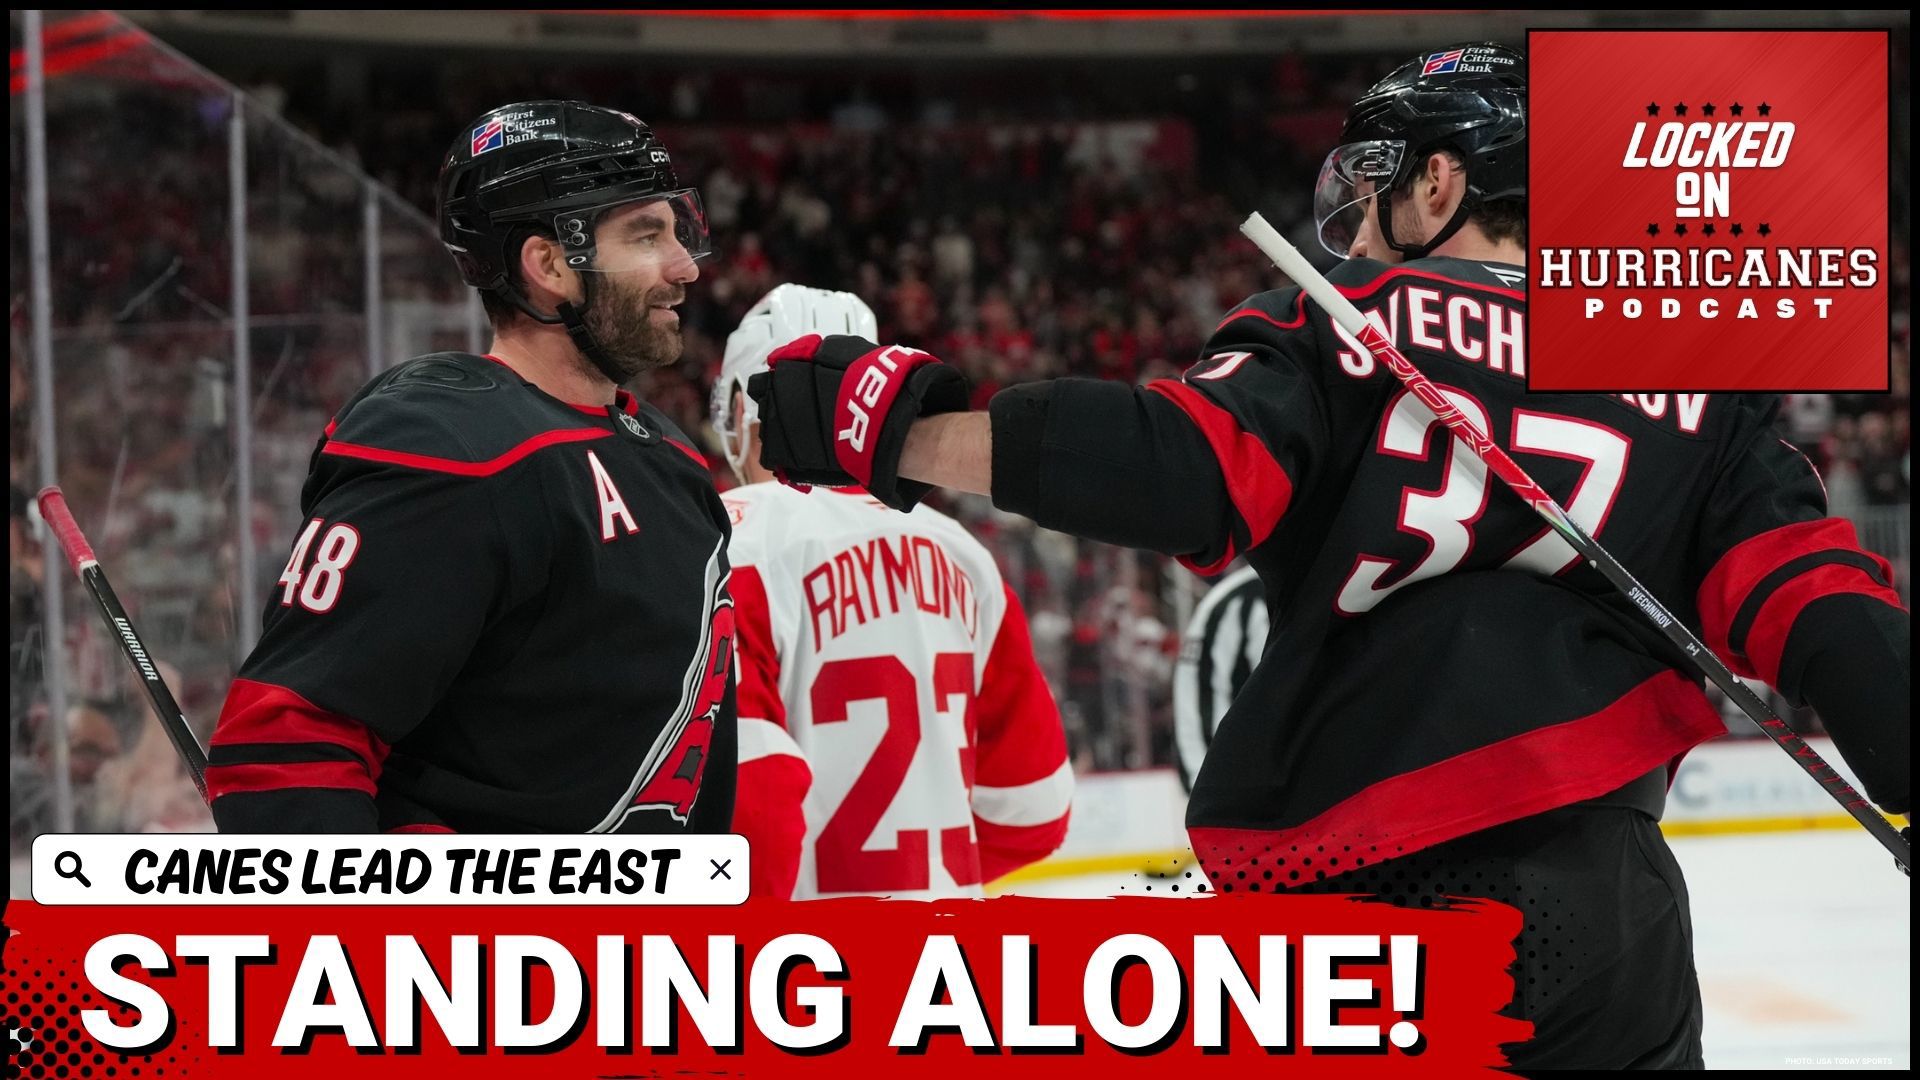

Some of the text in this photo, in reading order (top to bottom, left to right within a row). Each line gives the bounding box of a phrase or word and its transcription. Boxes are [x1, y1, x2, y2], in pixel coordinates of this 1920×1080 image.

[1458, 63, 1493, 73] Bank
[1462, 54, 1515, 65] Citizens
[1466, 47, 1496, 55] First
[505, 117, 556, 133] Citizens
[506, 110, 534, 121] First
[506, 129, 539, 146] Bank
[587, 449, 640, 544] A
[1335, 383, 1632, 619] 37
[277, 517, 362, 615] 48
[803, 534, 978, 653] RAYMOND
[1628, 586, 1673, 629] SVECHNIKOV
[114, 616, 159, 681] WARRIOR
[810, 652, 981, 894] 23
